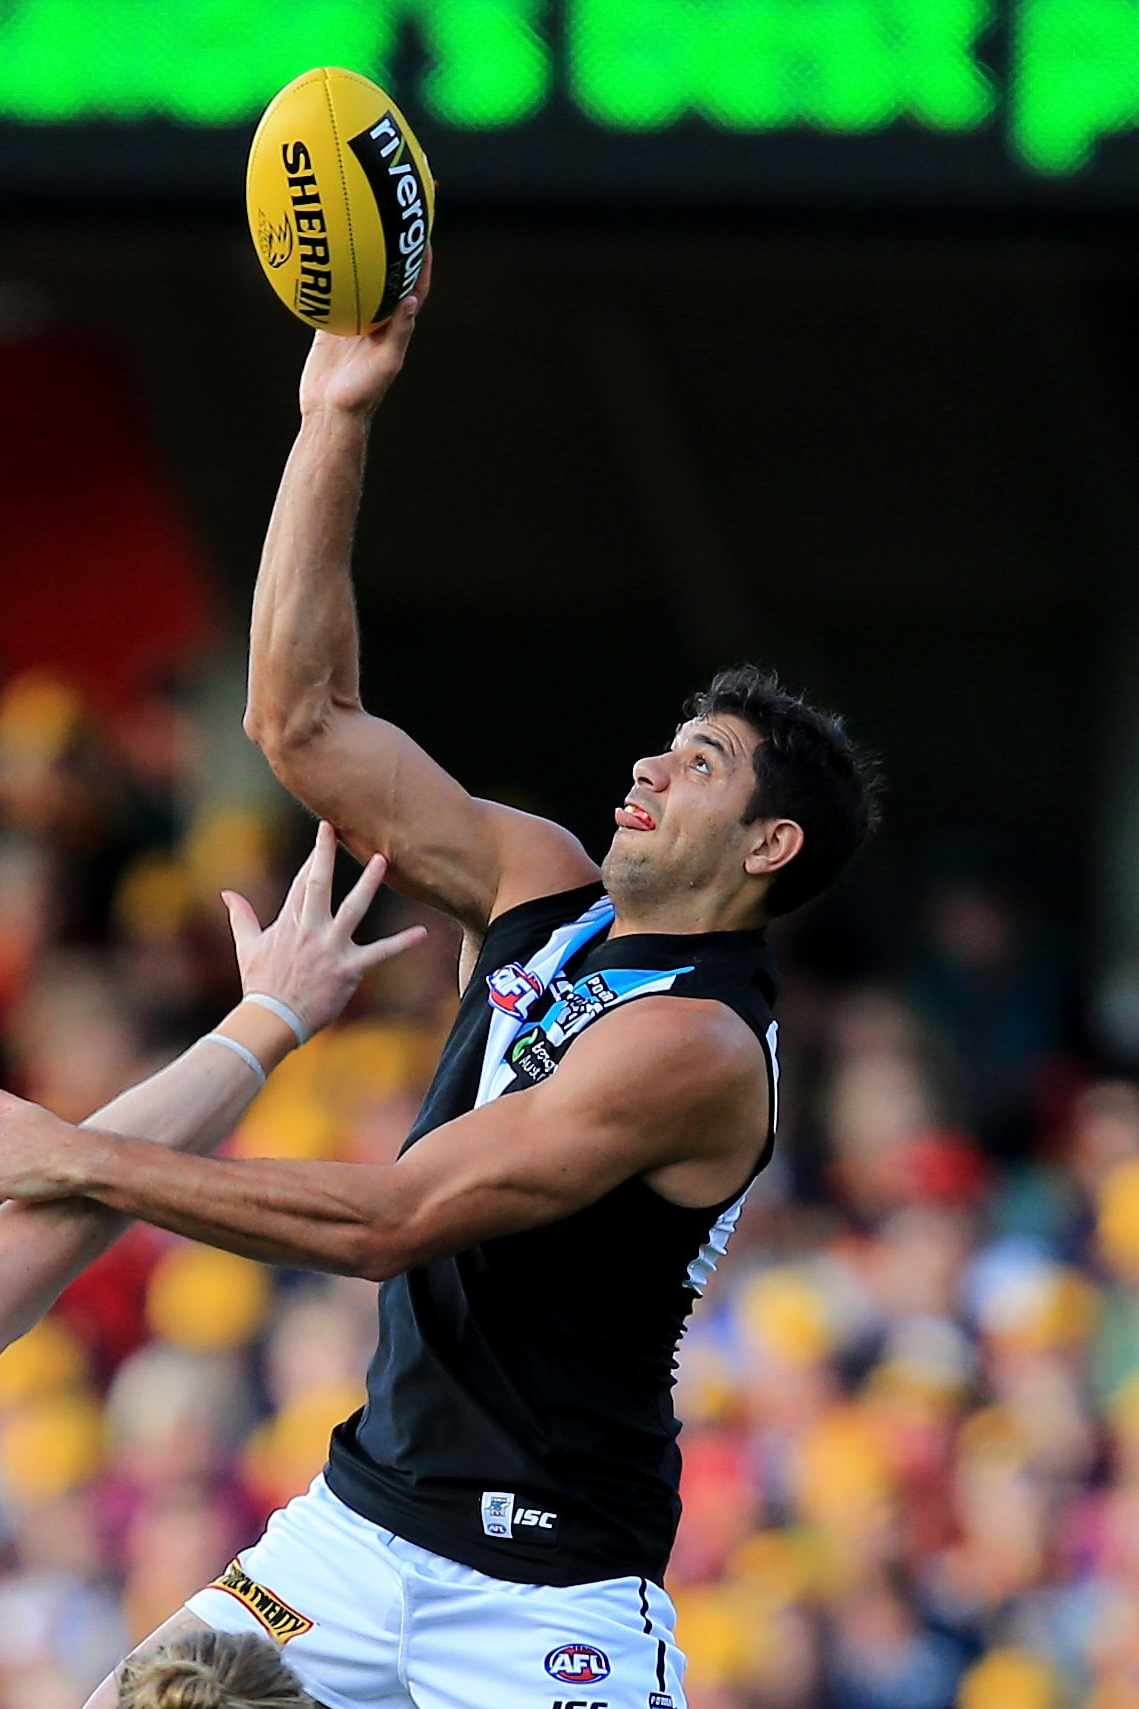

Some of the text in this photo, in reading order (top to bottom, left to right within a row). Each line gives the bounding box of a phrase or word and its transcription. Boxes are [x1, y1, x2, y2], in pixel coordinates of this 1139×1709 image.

[282, 141, 333, 324] SHERRIN
[513, 1508, 558, 1529] ISC
[250, 1586, 306, 1636] TWENTY
[550, 1653, 608, 1674] AFL
